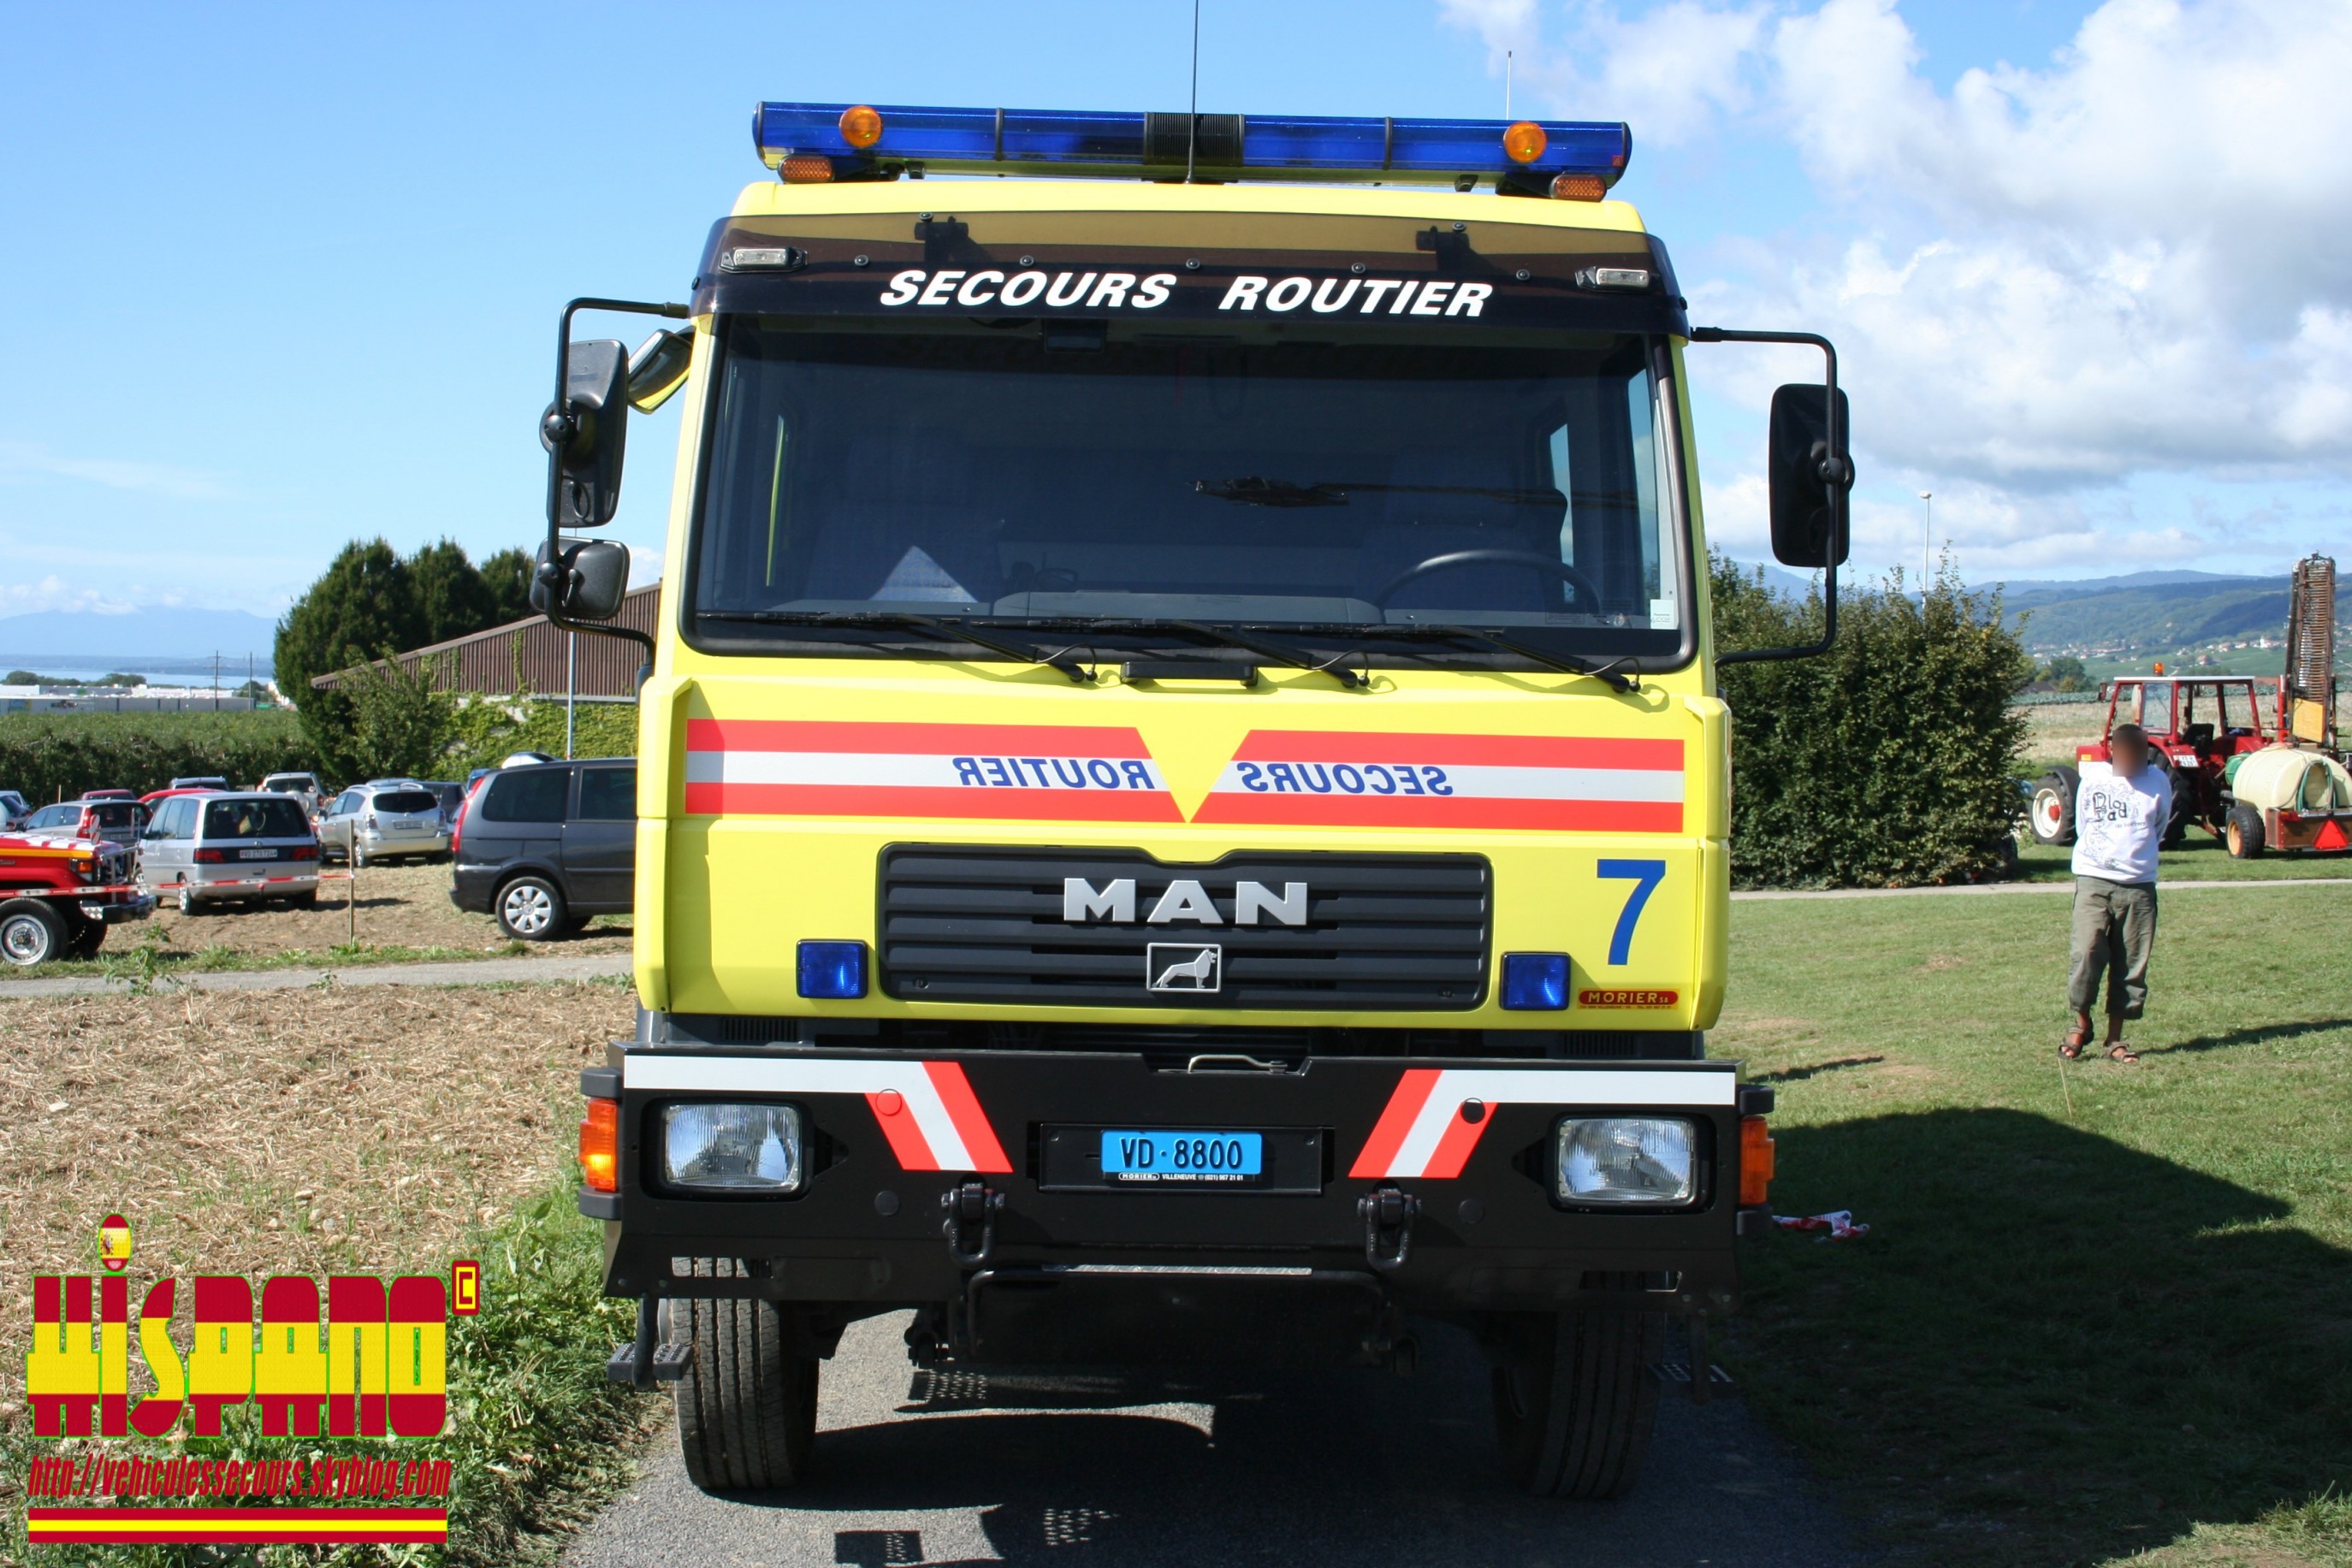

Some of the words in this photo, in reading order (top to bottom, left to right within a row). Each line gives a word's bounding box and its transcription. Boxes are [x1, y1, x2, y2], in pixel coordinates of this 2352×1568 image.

[879, 269, 1177, 310] SECOURS
[1218, 275, 1493, 318] ROUTIER
[1063, 878, 1308, 925] MAN
[1597, 859, 1666, 965] 7
[1588, 991, 1657, 1003] MORIER
[1119, 1138, 1154, 1169] VD
[1173, 1139, 1243, 1169] 8800
